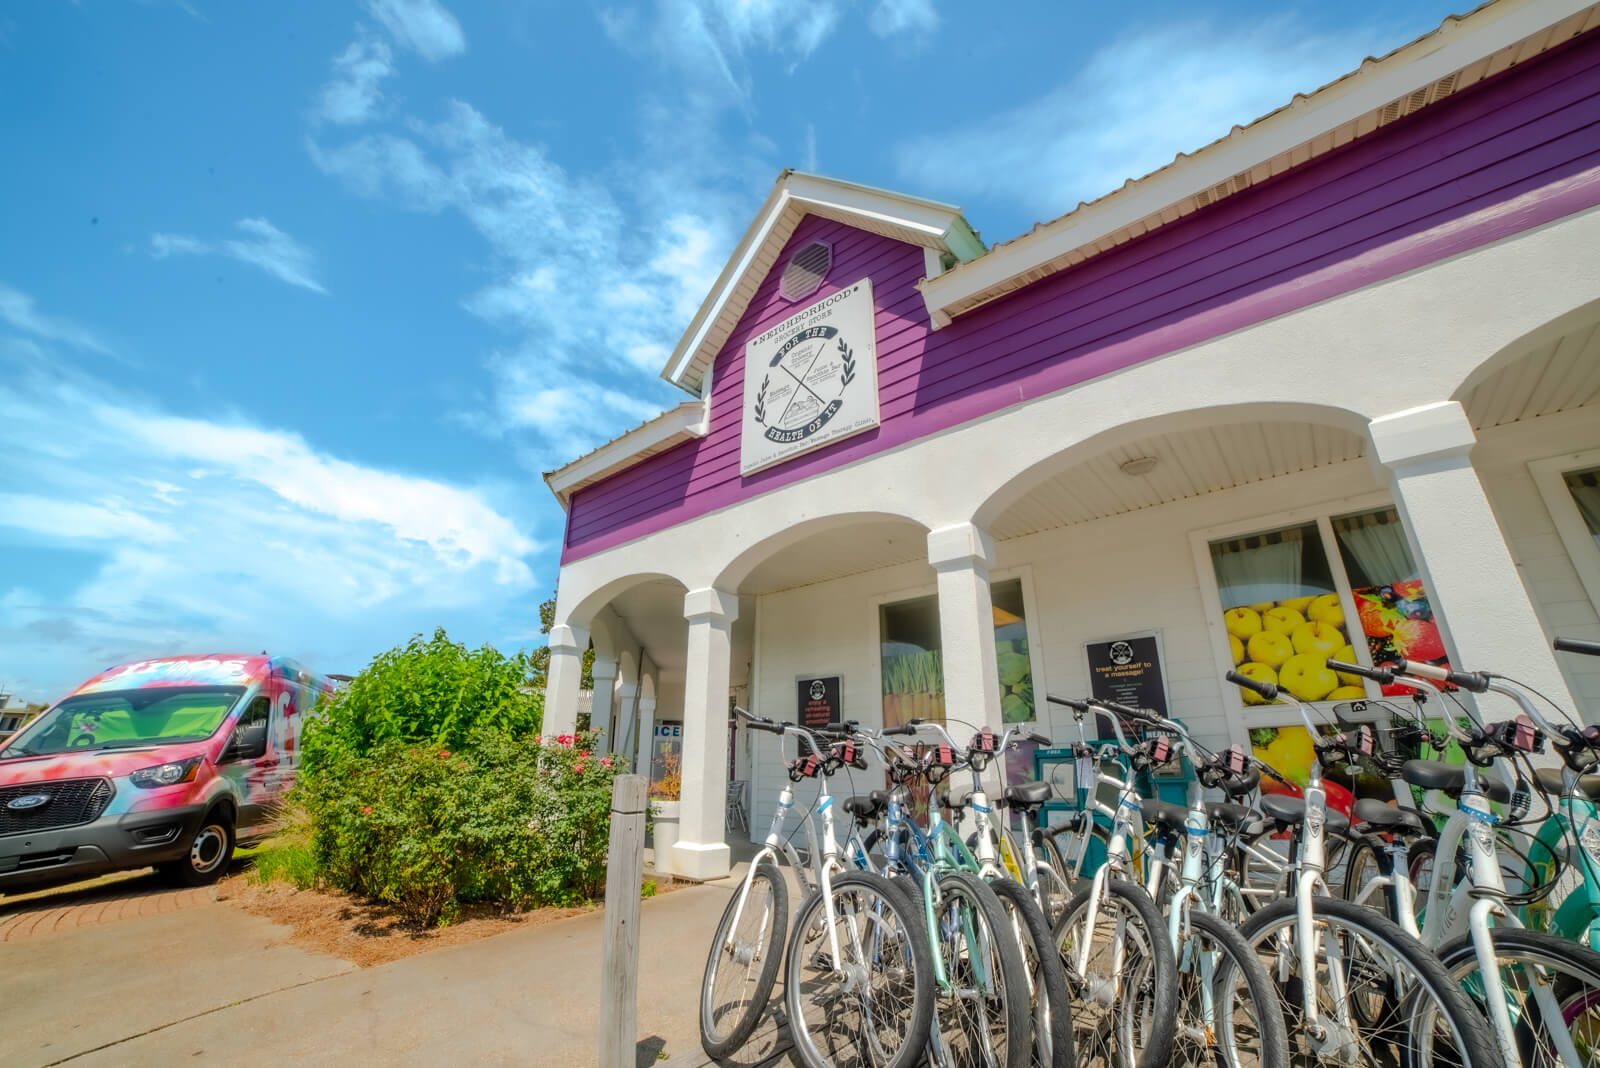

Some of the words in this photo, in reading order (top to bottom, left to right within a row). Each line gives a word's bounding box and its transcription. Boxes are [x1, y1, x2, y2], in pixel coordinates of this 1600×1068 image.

[758, 289, 852, 344] NEIGHBORHOOD
[774, 323, 805, 344] GROCERY
[808, 309, 833, 327] STORE
[779, 337, 799, 358] FOR
[805, 327, 827, 339] THE
[768, 428, 803, 441] HEALTH
[809, 418, 821, 432] OF
[825, 404, 837, 418] IT
[1114, 662, 1142, 671] yourself
[655, 726, 680, 737] ICE
